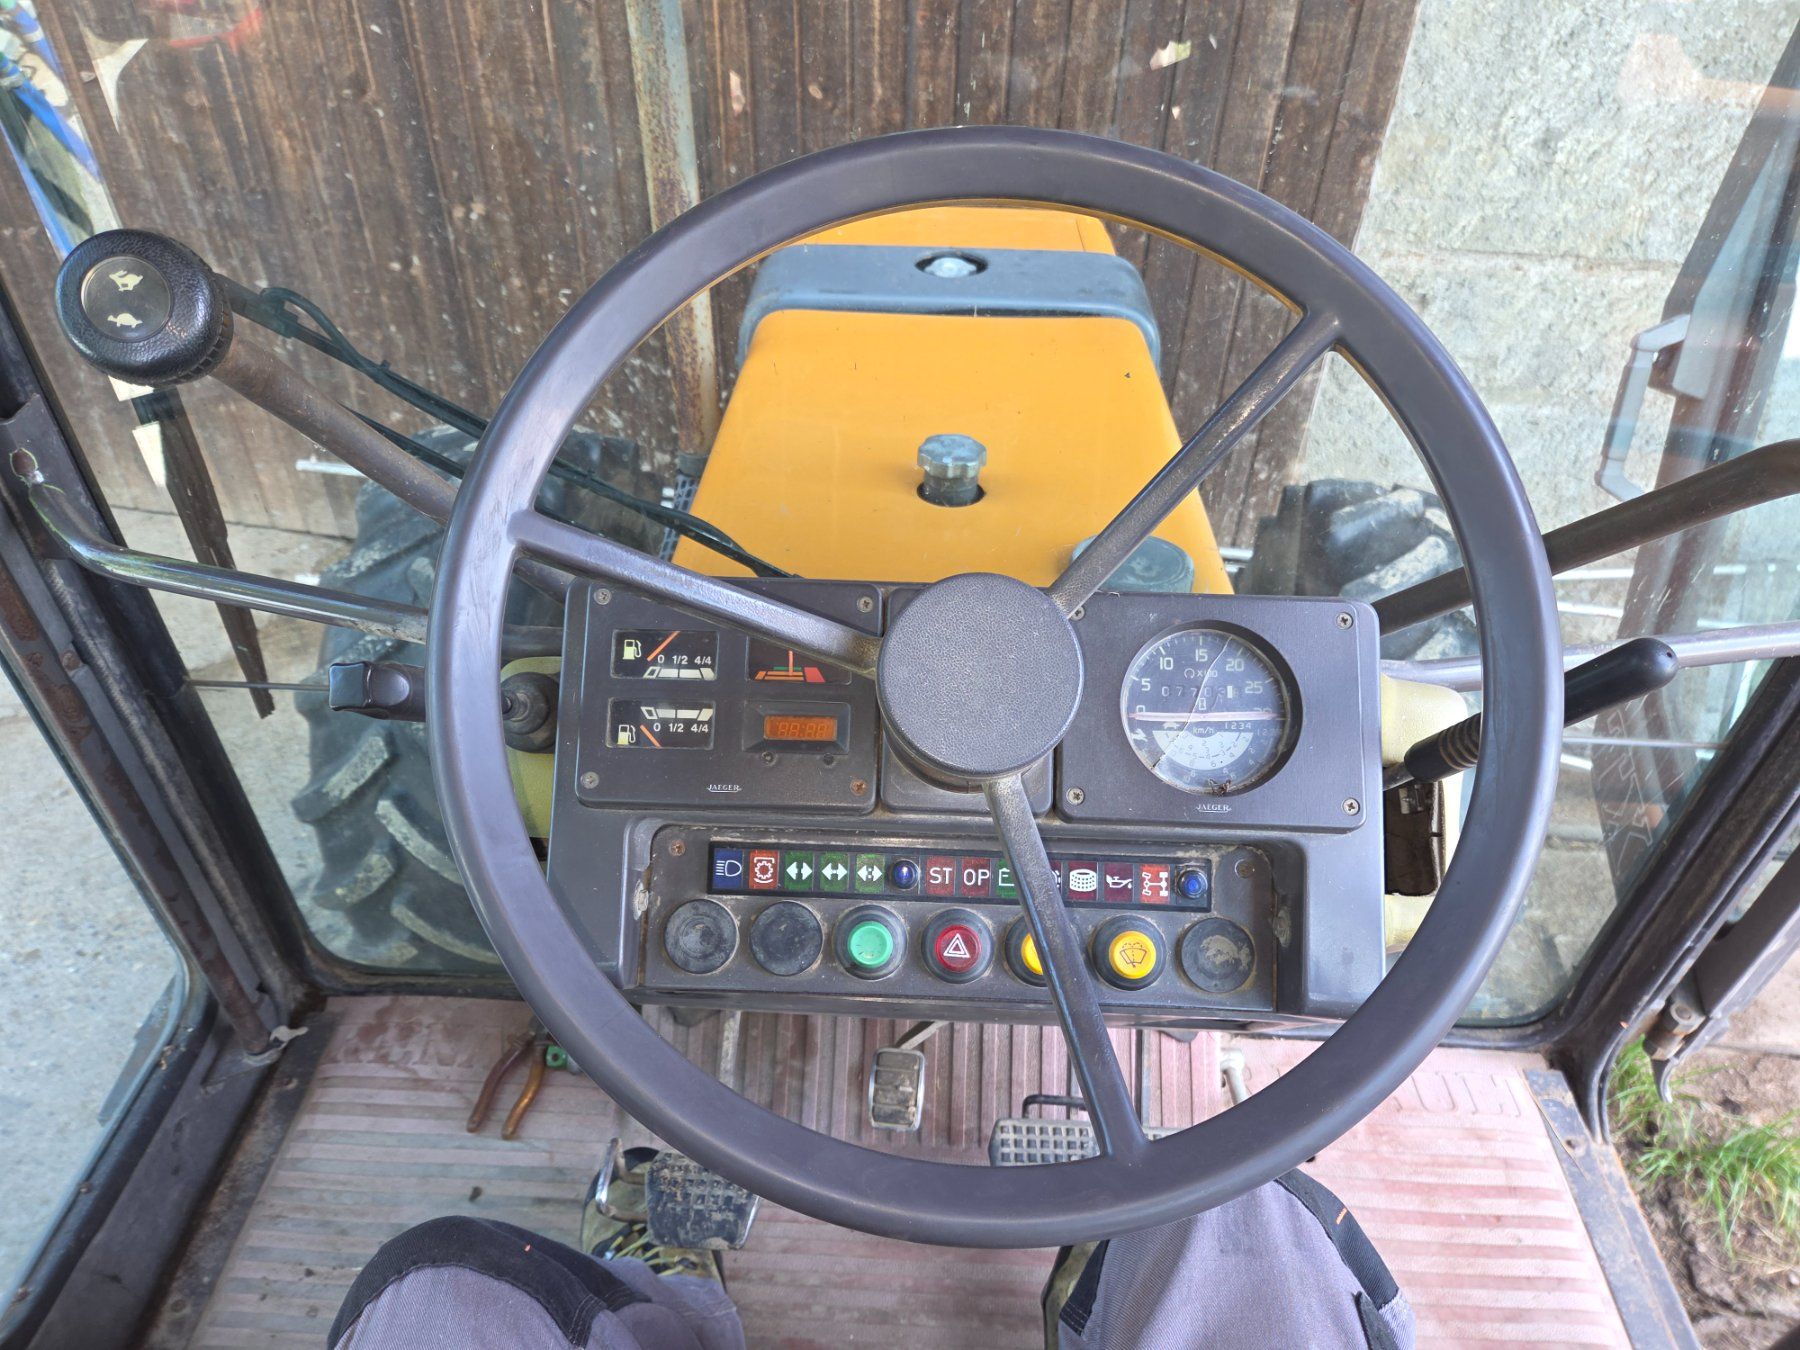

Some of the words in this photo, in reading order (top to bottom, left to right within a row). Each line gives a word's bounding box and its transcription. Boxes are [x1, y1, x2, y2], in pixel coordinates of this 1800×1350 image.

[657, 654, 665, 664] 0
[672, 654, 688, 665] 1/2
[694, 655, 712, 665] 4/4
[1195, 649, 1208, 662] 15
[1160, 657, 1174, 670] 10
[1226, 658, 1245, 672] 20
[1141, 678, 1151, 691] 5
[1245, 681, 1263, 694] 25
[653, 722, 661, 732] 0
[668, 723, 684, 733] 1/2
[690, 723, 709, 733] 4/4
[707, 784, 741, 792] JAEGER
[1196, 803, 1232, 812] JAEGER
[929, 867, 953, 885] ST
[963, 868, 990, 886] OP
